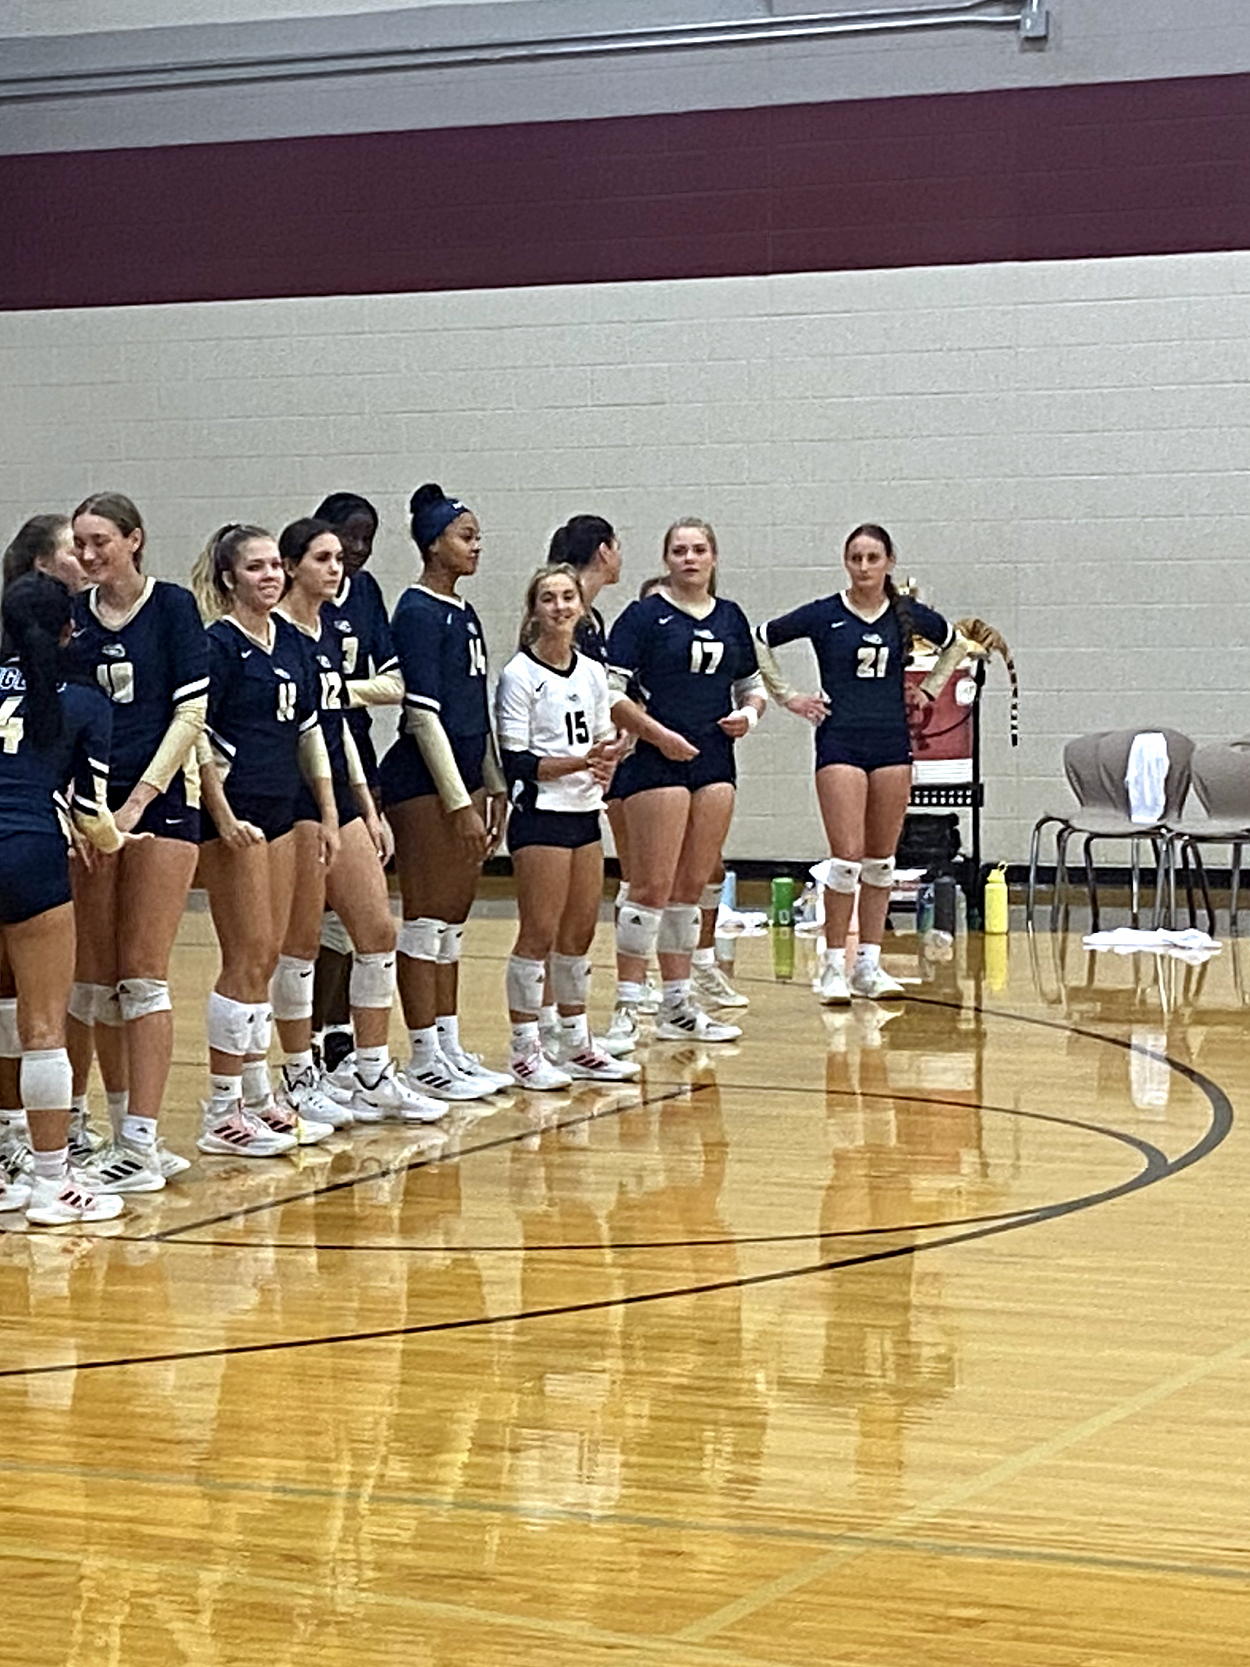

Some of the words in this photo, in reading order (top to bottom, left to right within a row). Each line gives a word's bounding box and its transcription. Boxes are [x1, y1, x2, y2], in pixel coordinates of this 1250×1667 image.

[691, 640, 724, 674] 17
[856, 646, 889, 678] 21
[319, 671, 342, 710] 12
[565, 710, 590, 746] 15
